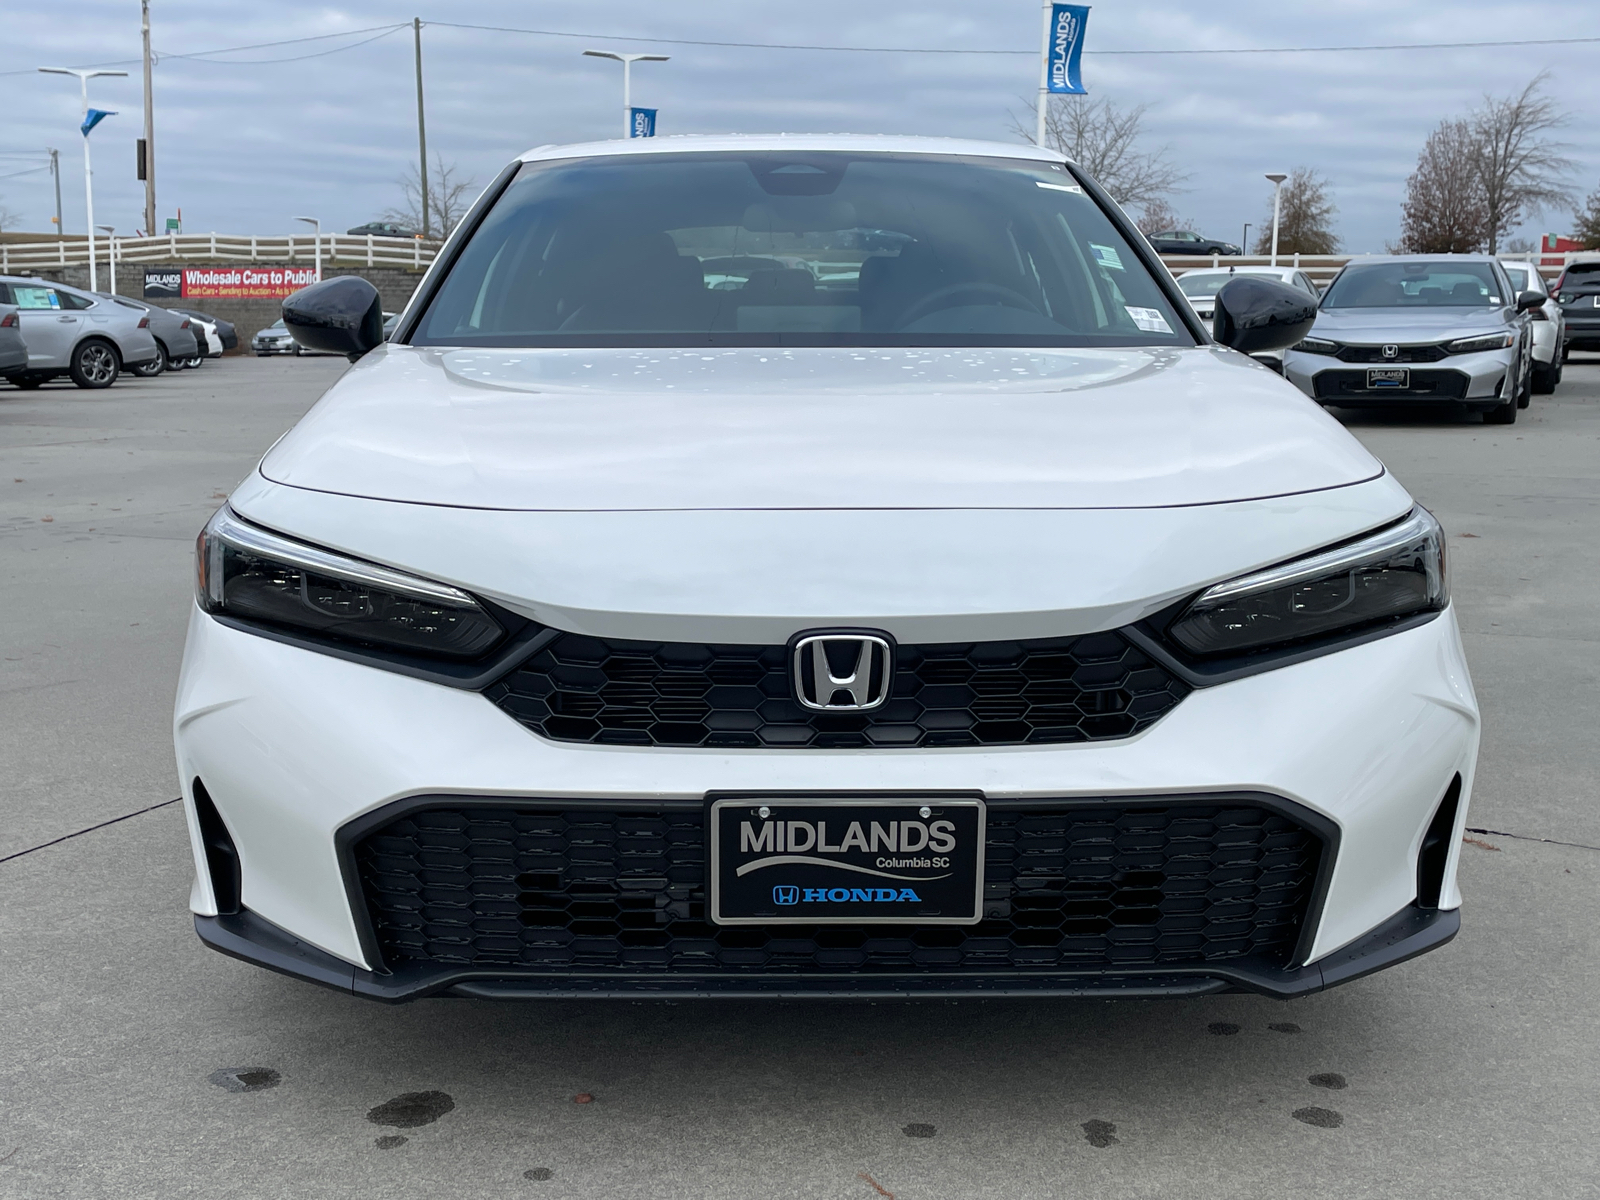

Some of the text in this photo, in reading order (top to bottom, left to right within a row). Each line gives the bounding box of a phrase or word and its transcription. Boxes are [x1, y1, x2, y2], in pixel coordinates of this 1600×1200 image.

[1053, 11, 1071, 88] MIDLANDS
[145, 274, 181, 283] MIDLANDS
[186, 270, 241, 285] Wholesale
[242, 270, 269, 285] Cars
[270, 271, 282, 285] to
[740, 820, 956, 853] MIDLANDS
[876, 857, 950, 868] Columbia SC
[802, 888, 922, 902] HONDA
